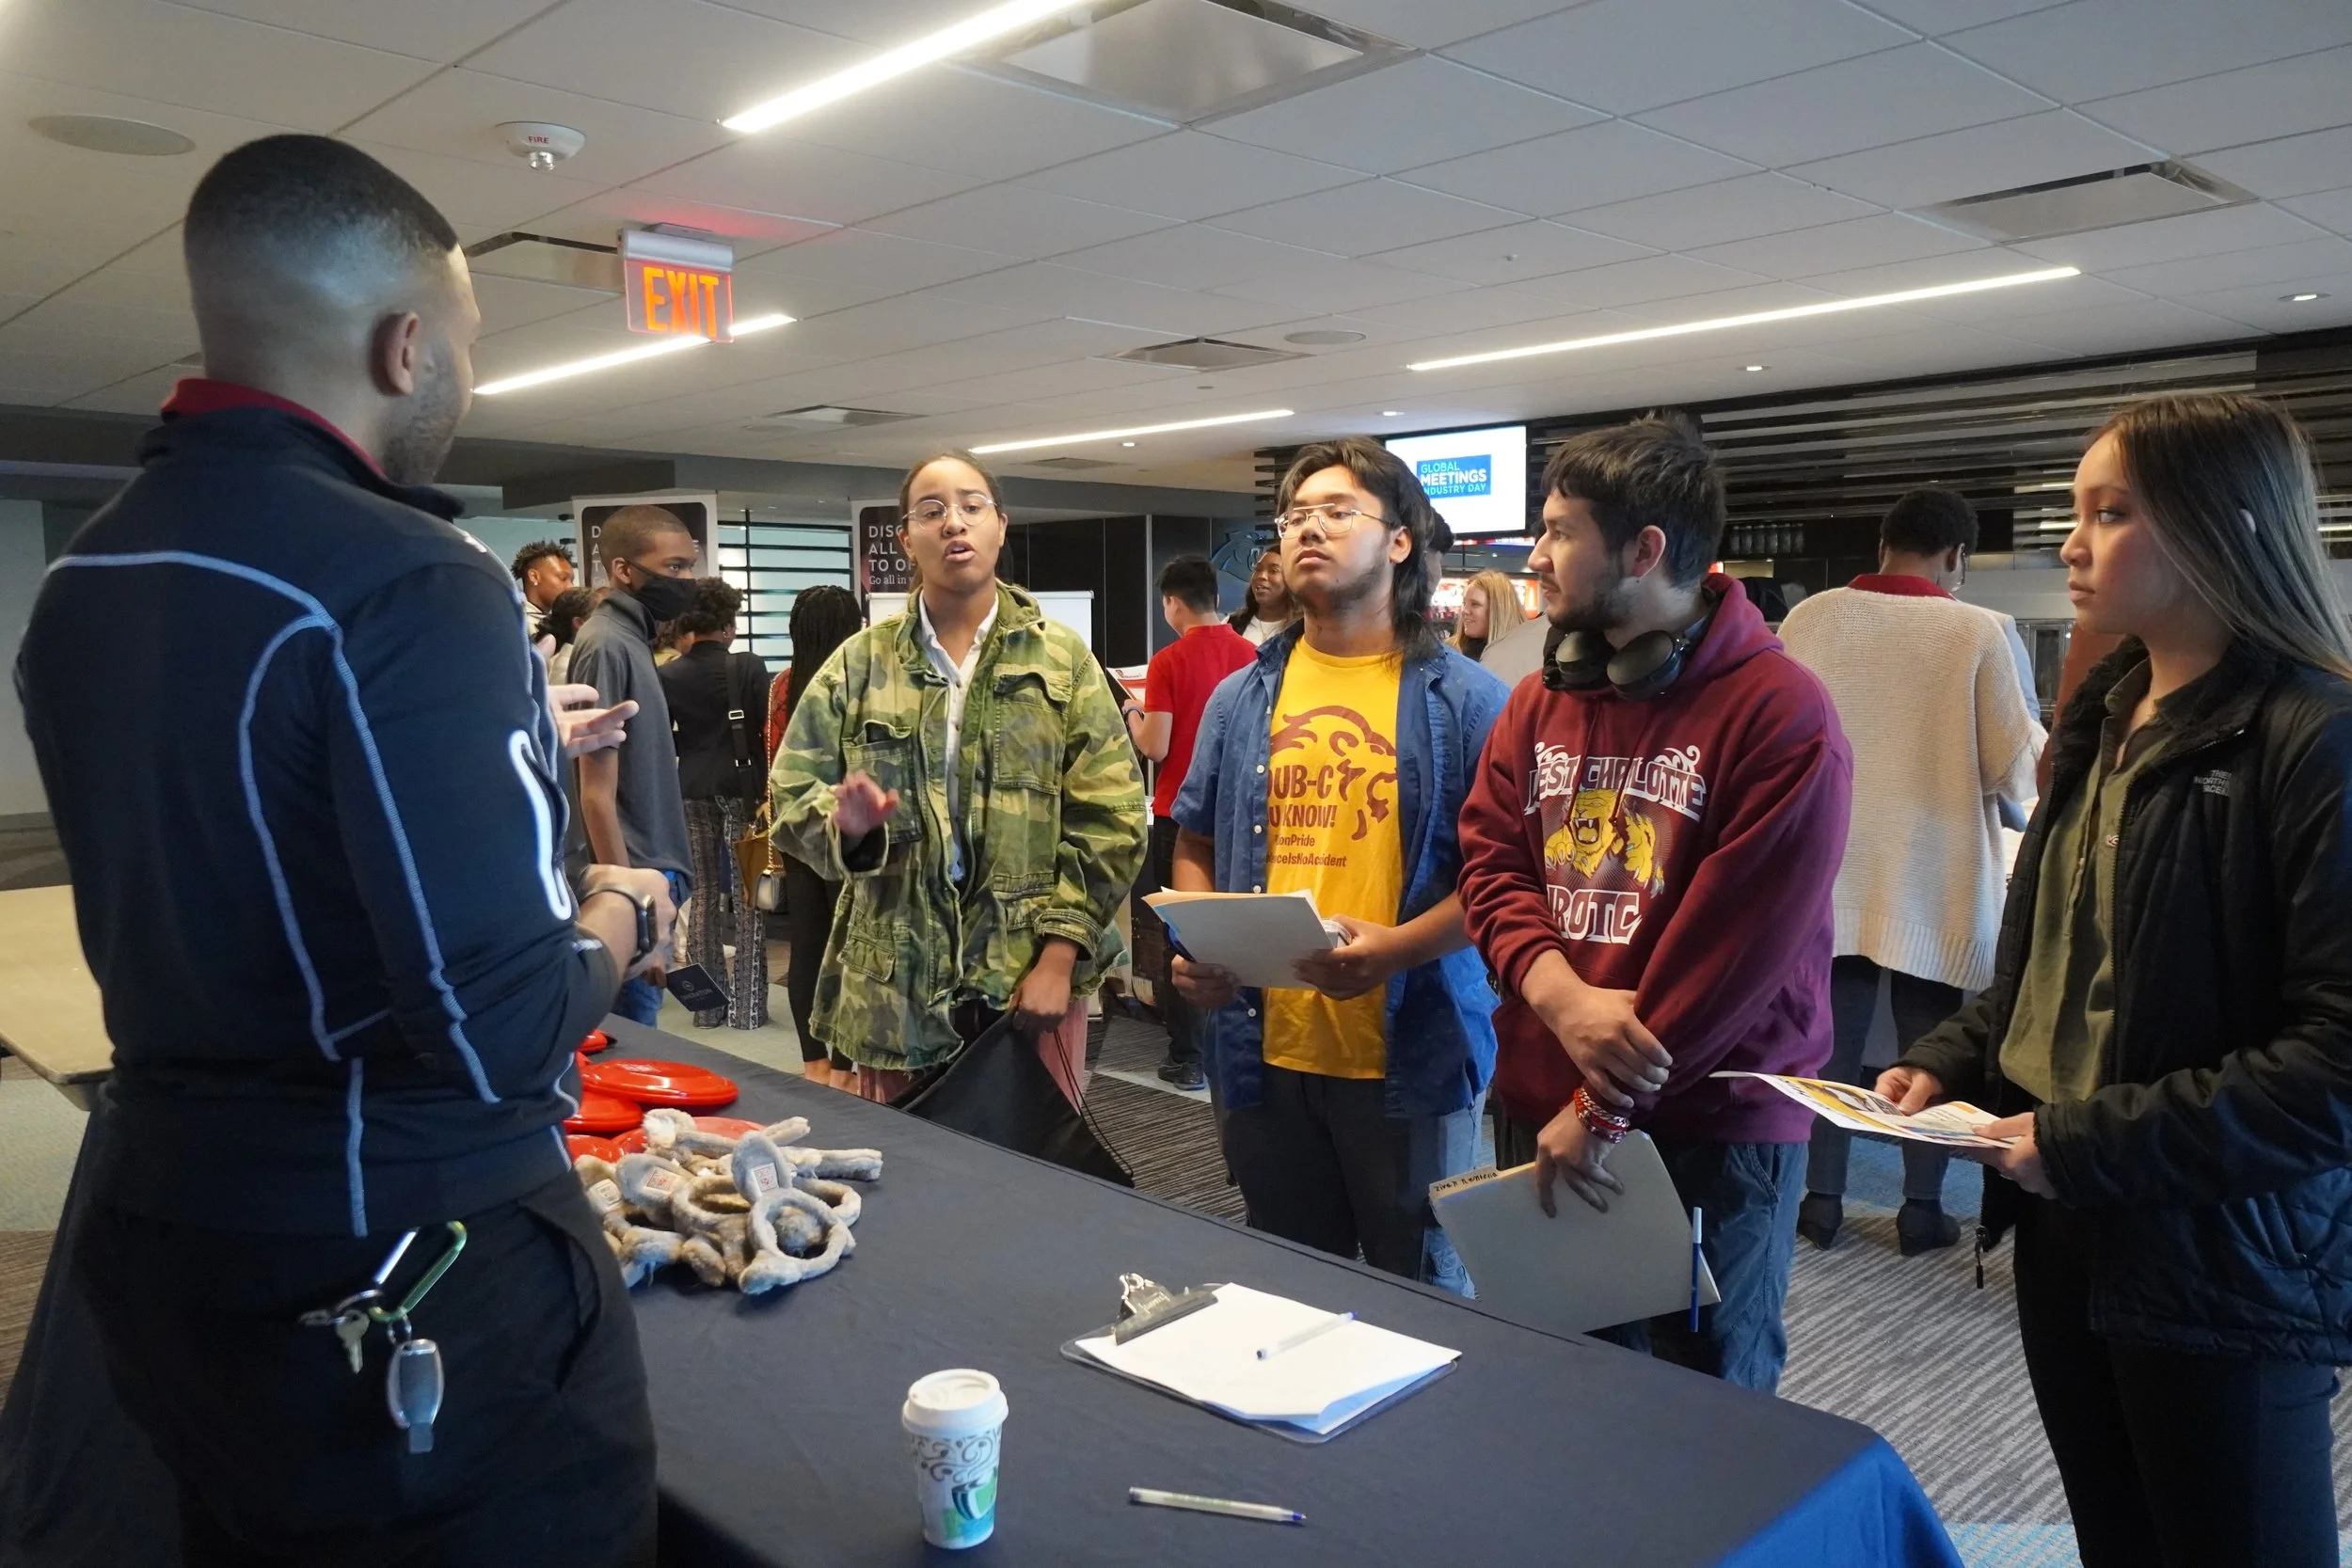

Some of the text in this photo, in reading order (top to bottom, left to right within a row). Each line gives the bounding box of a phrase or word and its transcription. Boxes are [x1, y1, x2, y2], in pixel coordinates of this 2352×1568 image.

[528, 135, 549, 144] FIRE
[643, 266, 719, 338] EXIT
[1421, 461, 1460, 474] GLOBAL
[1420, 468, 1486, 486] MEETINGS
[1422, 483, 1486, 496] NDUSTRY DAY
[868, 543, 898, 555] ALL
[868, 560, 889, 571] TO
[869, 576, 882, 585] Go
[884, 575, 895, 584] all
[898, 575, 906, 584] in
[1579, 756, 1708, 823] CHALOTTE
[1283, 803, 1338, 828] KNOW!
